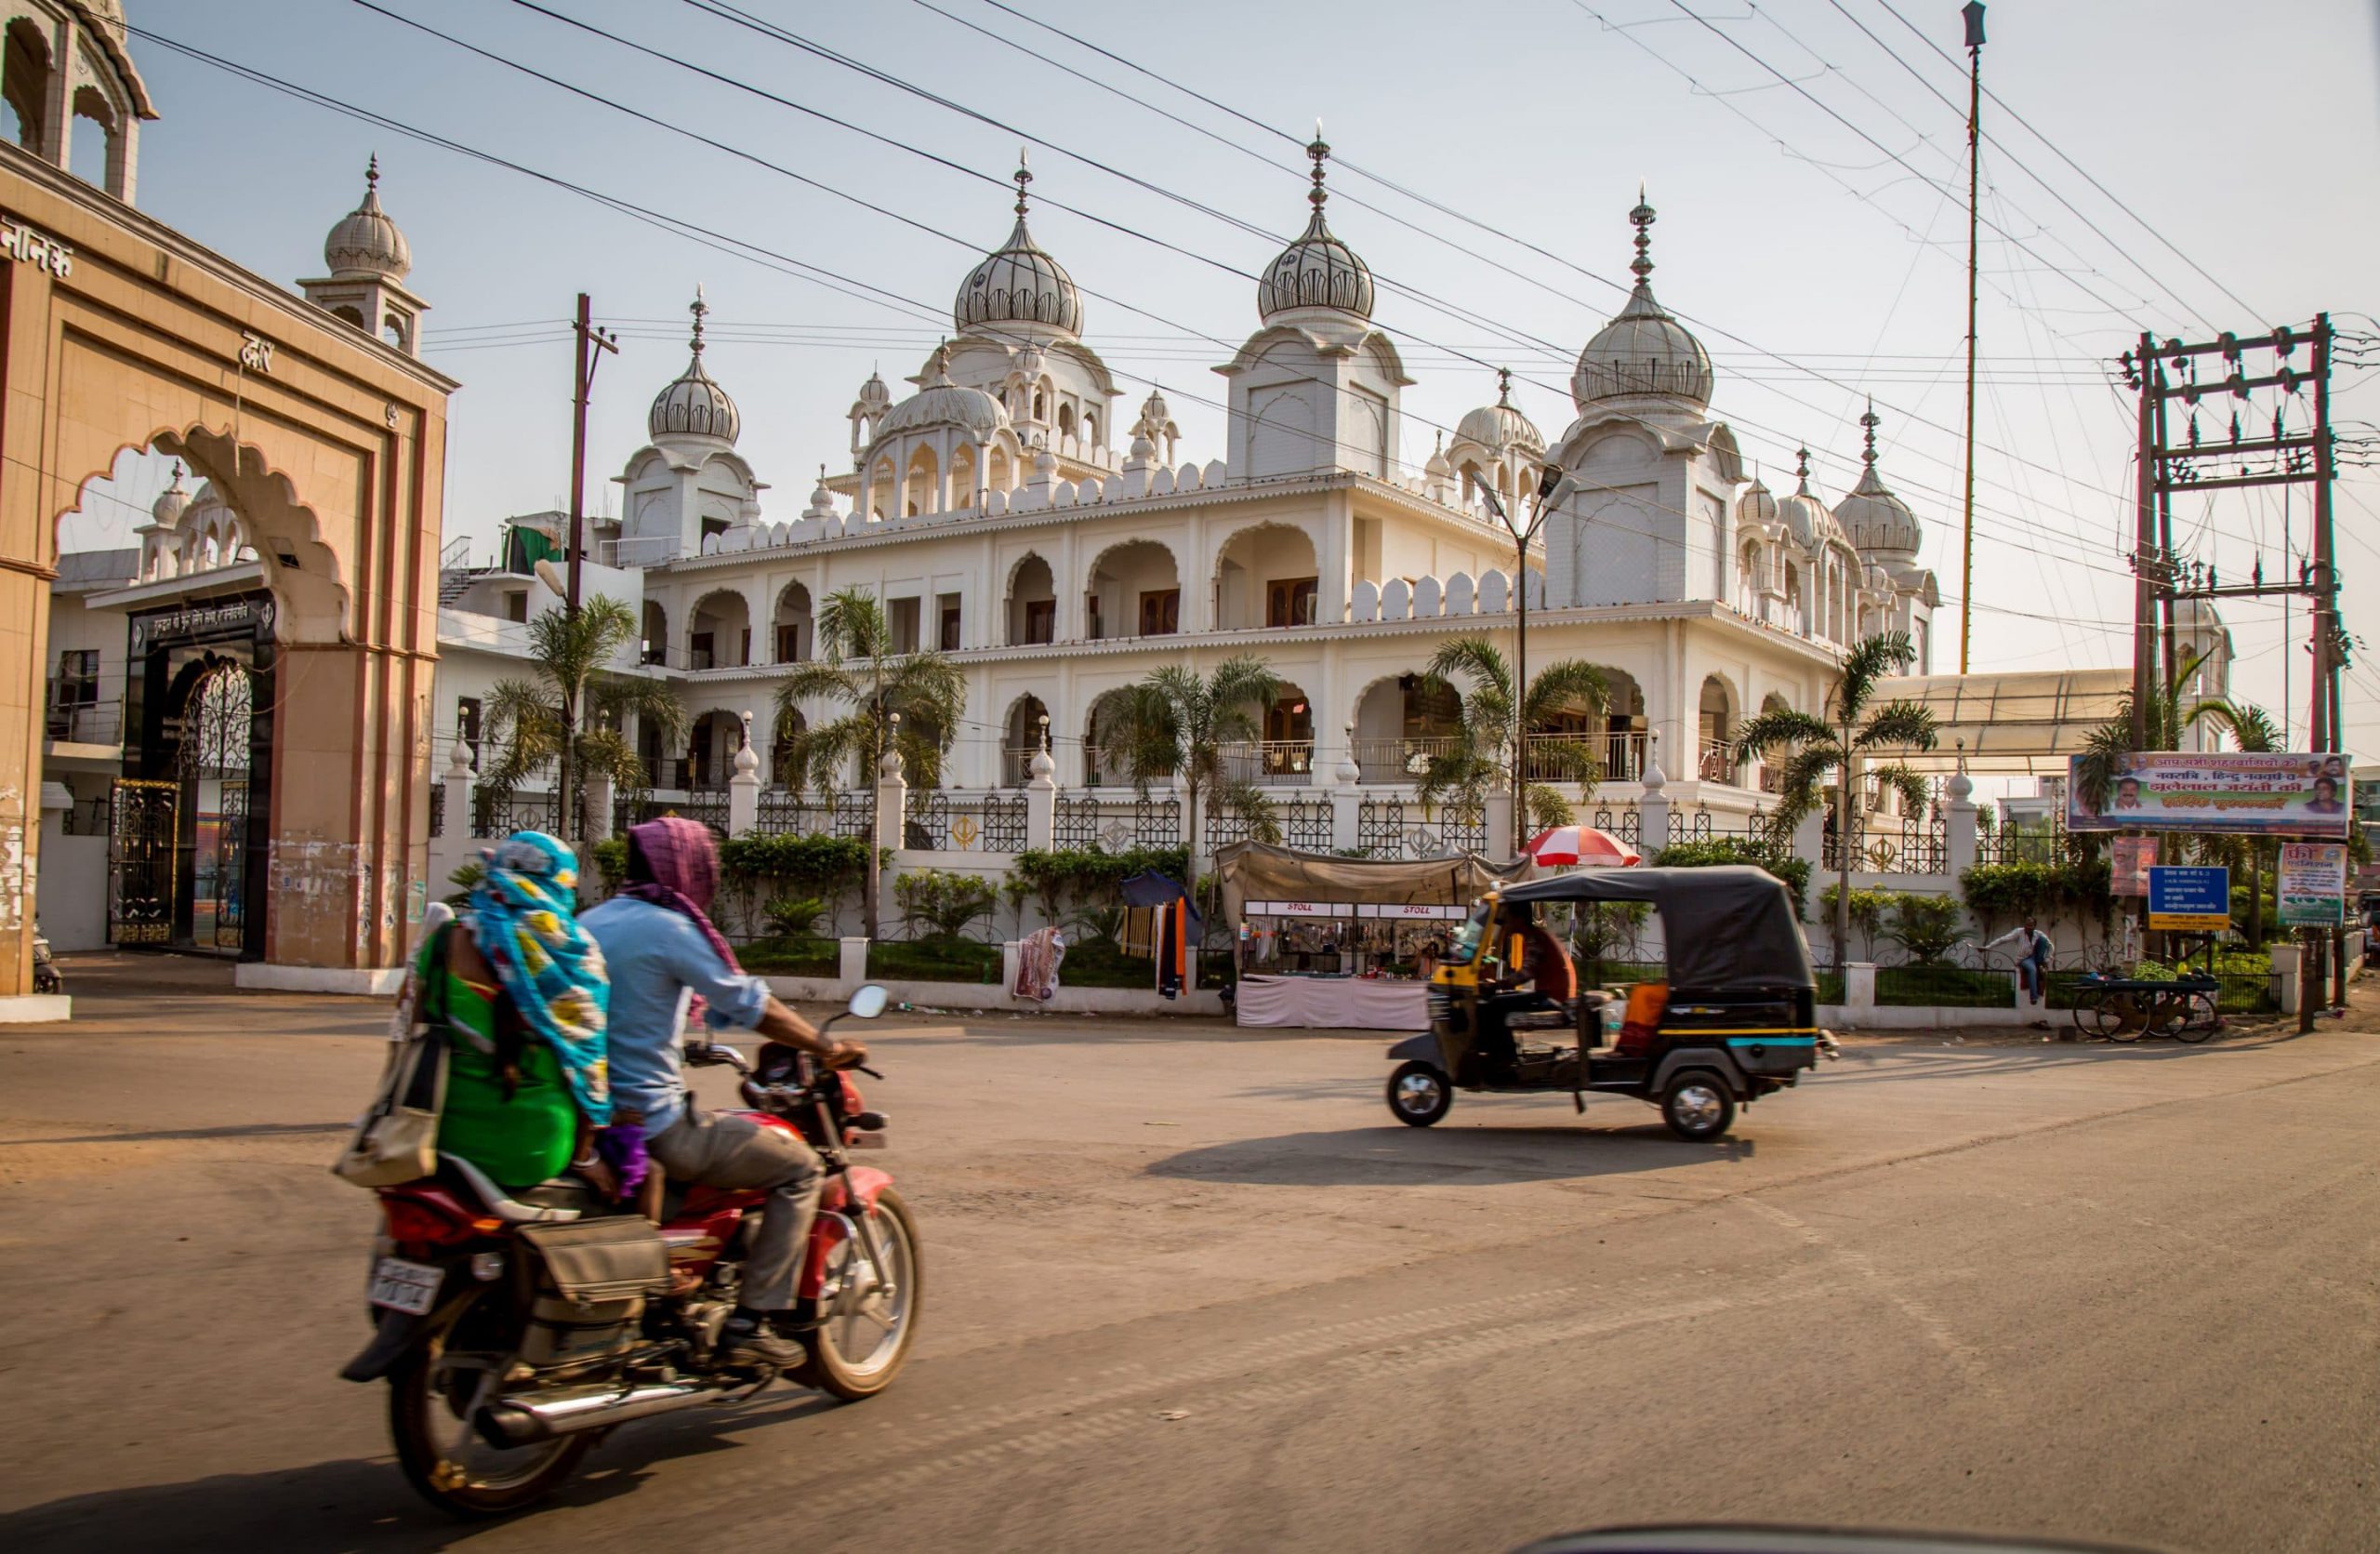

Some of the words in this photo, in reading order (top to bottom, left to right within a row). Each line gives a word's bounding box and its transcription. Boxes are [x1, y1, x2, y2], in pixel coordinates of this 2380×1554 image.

[0, 214, 74, 278] नानक
[242, 329, 275, 373] द्वार
[2156, 758, 2180, 767] आप
[2185, 757, 2206, 767] सभी
[2281, 757, 2299, 767] को
[2149, 781, 2217, 792] झूलेलाल
[2223, 782, 2272, 792] जयंती
[2279, 783, 2303, 792] की
[1287, 903, 1313, 911] STOLL
[1403, 906, 1431, 914] STOLL
